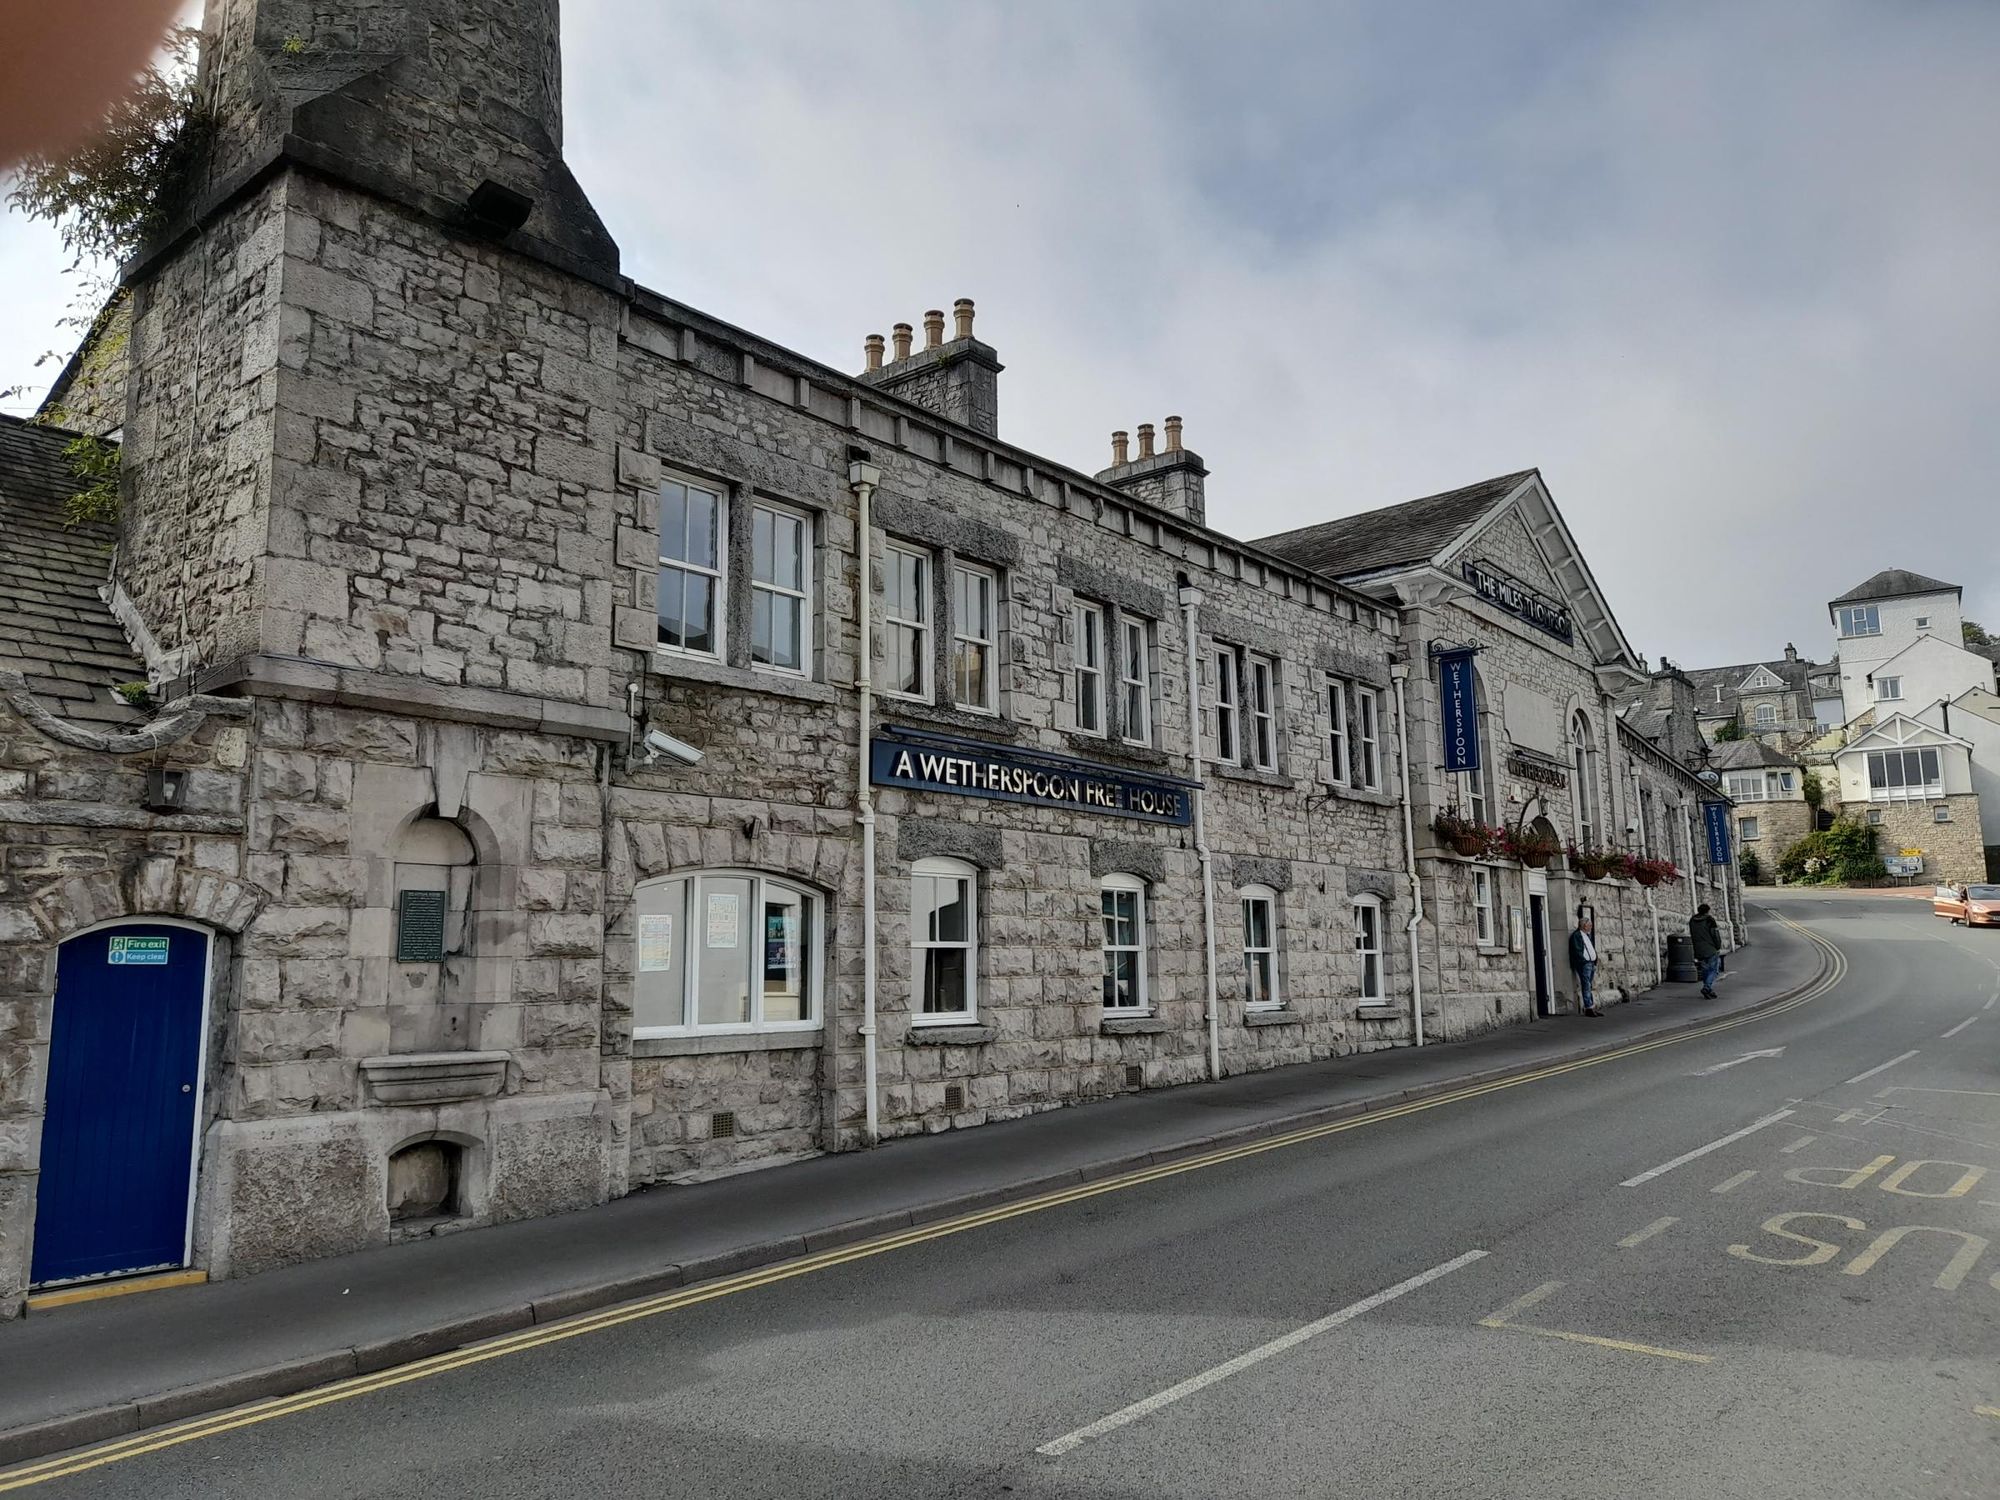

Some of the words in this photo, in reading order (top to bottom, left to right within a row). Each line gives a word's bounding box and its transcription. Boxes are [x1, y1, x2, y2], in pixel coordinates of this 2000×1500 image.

[1476, 570, 1496, 597] THE
[1499, 582, 1523, 611] MILES
[1450, 662, 1466, 766] WETHERSPOON
[896, 750, 914, 778] A
[920, 753, 1079, 802] WETHERSPOON
[1086, 780, 1123, 809] FREE
[1129, 789, 1182, 817] HOUSE
[1710, 806, 1723, 862] WETHERSPOON
[127, 940, 146, 949] Fire
[148, 940, 166, 949] exit
